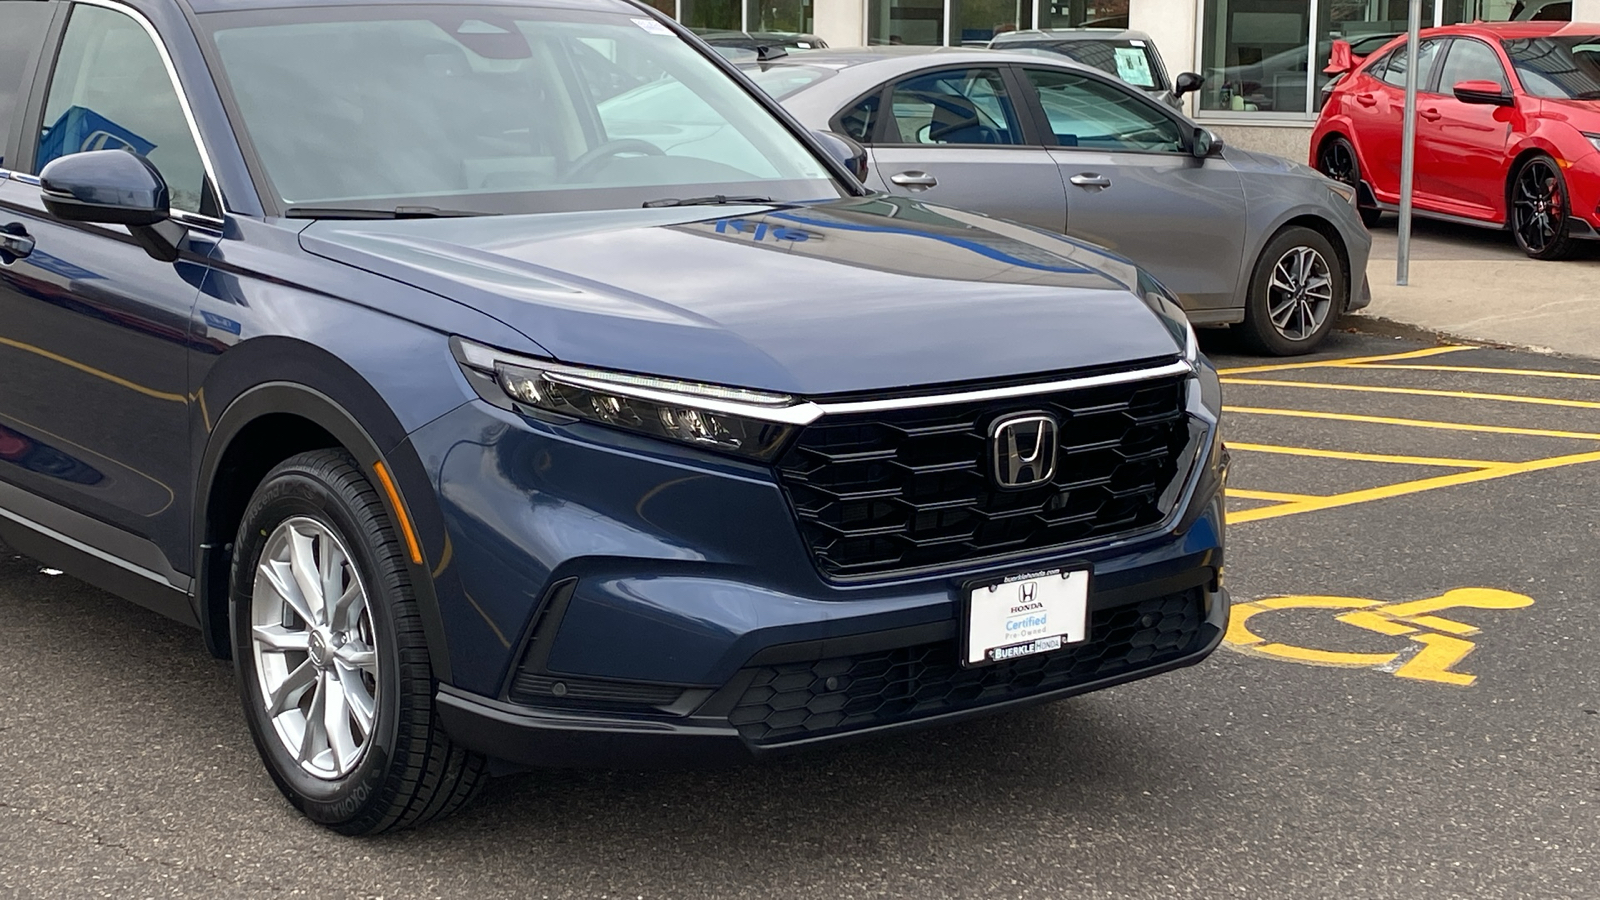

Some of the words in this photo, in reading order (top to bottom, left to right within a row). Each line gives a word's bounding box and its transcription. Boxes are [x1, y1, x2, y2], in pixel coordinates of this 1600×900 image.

[1011, 602, 1043, 613] HONDA
[1006, 613, 1047, 631] Certified
[1005, 627, 1047, 640] Pre-Owned
